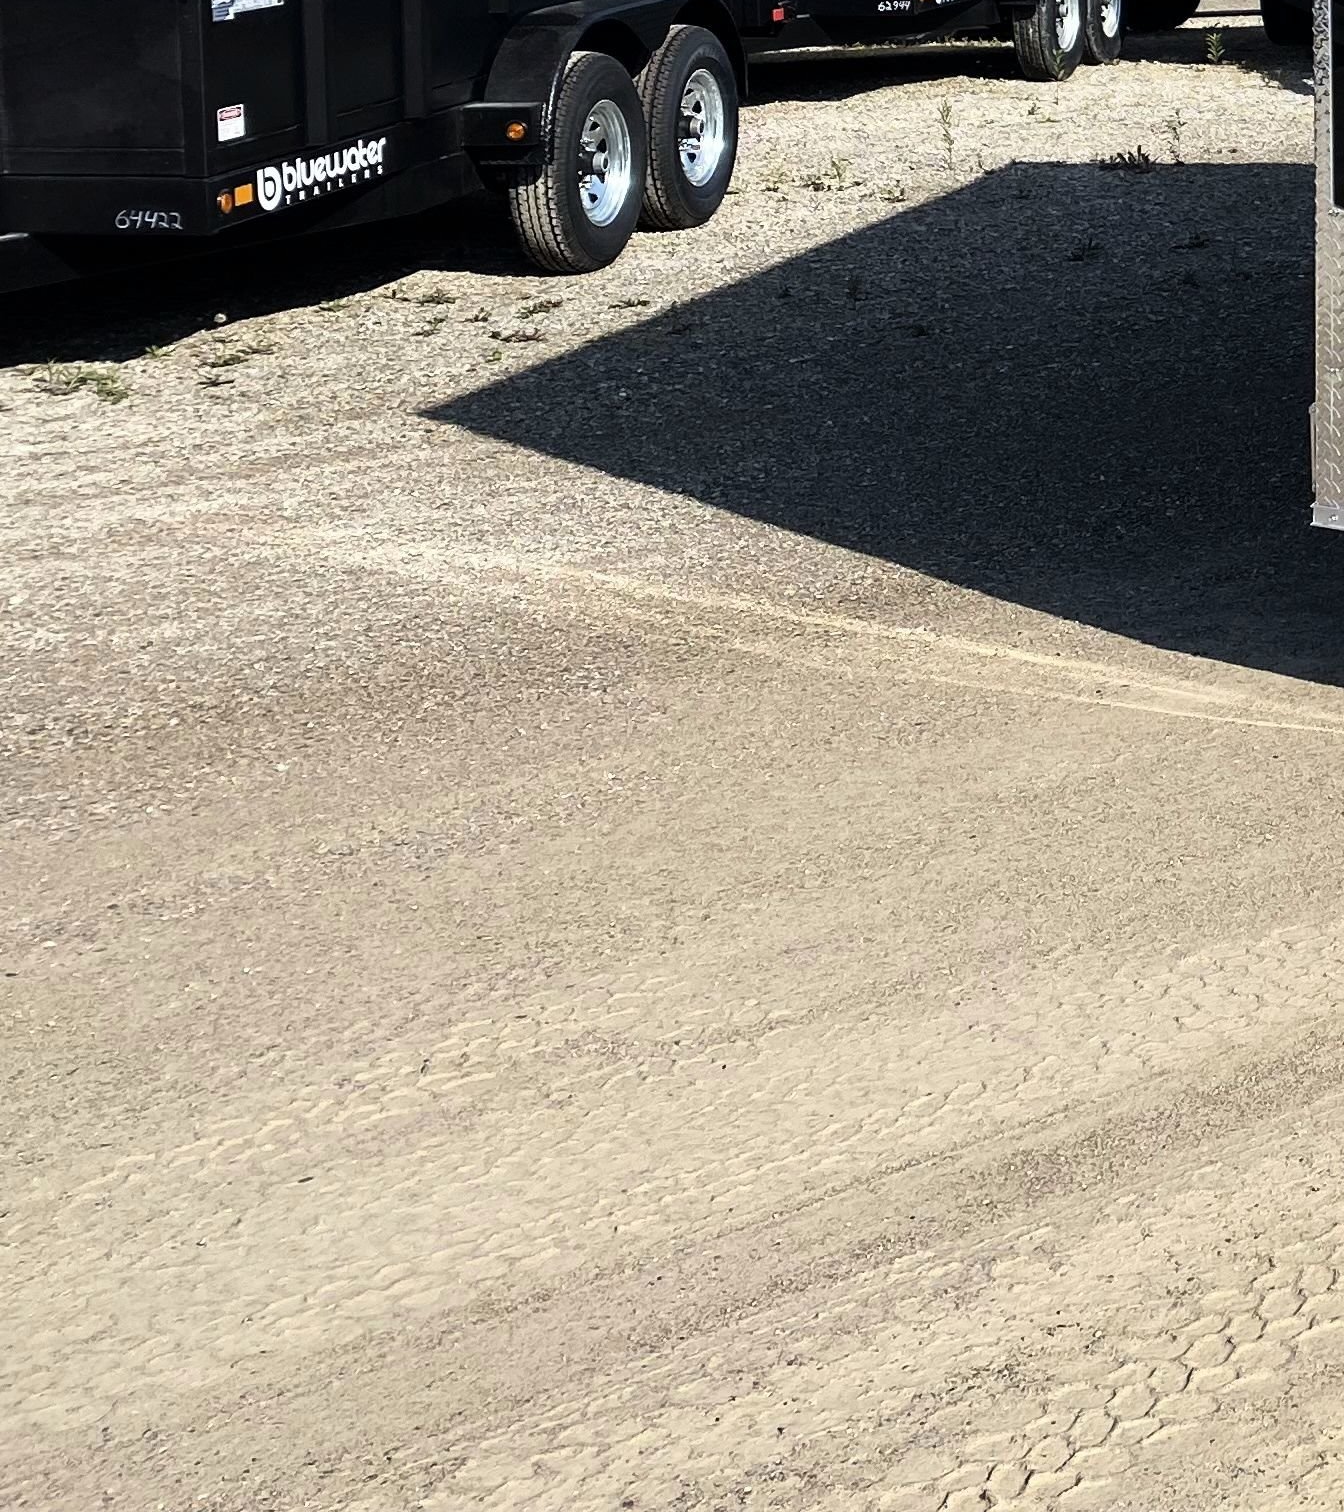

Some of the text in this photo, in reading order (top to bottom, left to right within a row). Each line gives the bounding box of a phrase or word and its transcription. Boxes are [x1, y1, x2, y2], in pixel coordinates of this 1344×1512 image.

[282, 137, 387, 192] bluewater
[285, 164, 384, 205] TRAILERS
[114, 209, 183, 230] 64422
